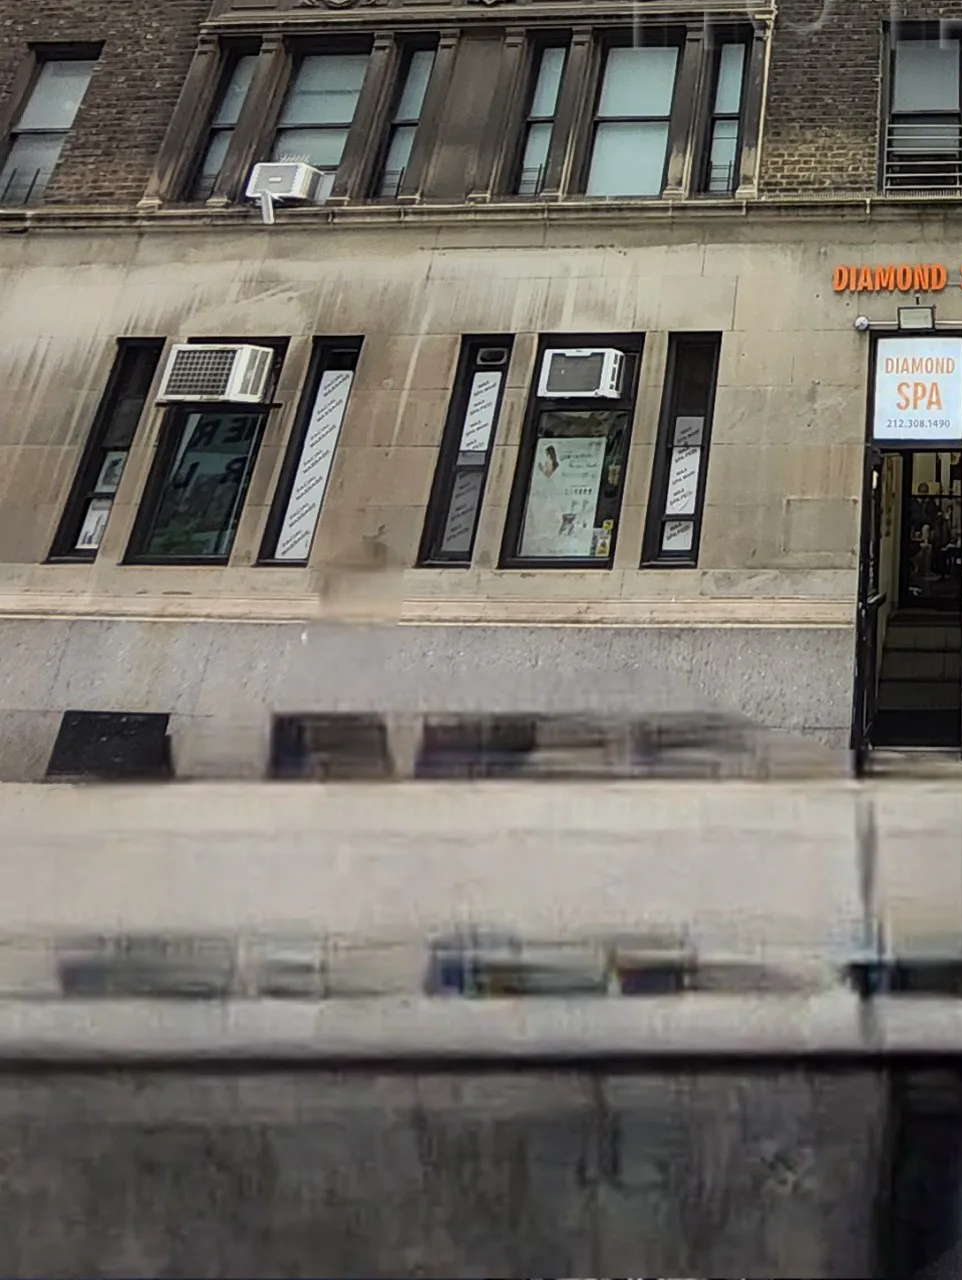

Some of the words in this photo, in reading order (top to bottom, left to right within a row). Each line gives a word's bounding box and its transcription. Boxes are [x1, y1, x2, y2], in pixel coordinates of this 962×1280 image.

[832, 263, 948, 293] DIAMOND
[885, 357, 956, 375] DIAMOND
[896, 381, 943, 411] SPA
[886, 418, 951, 429] 212.308.1490
